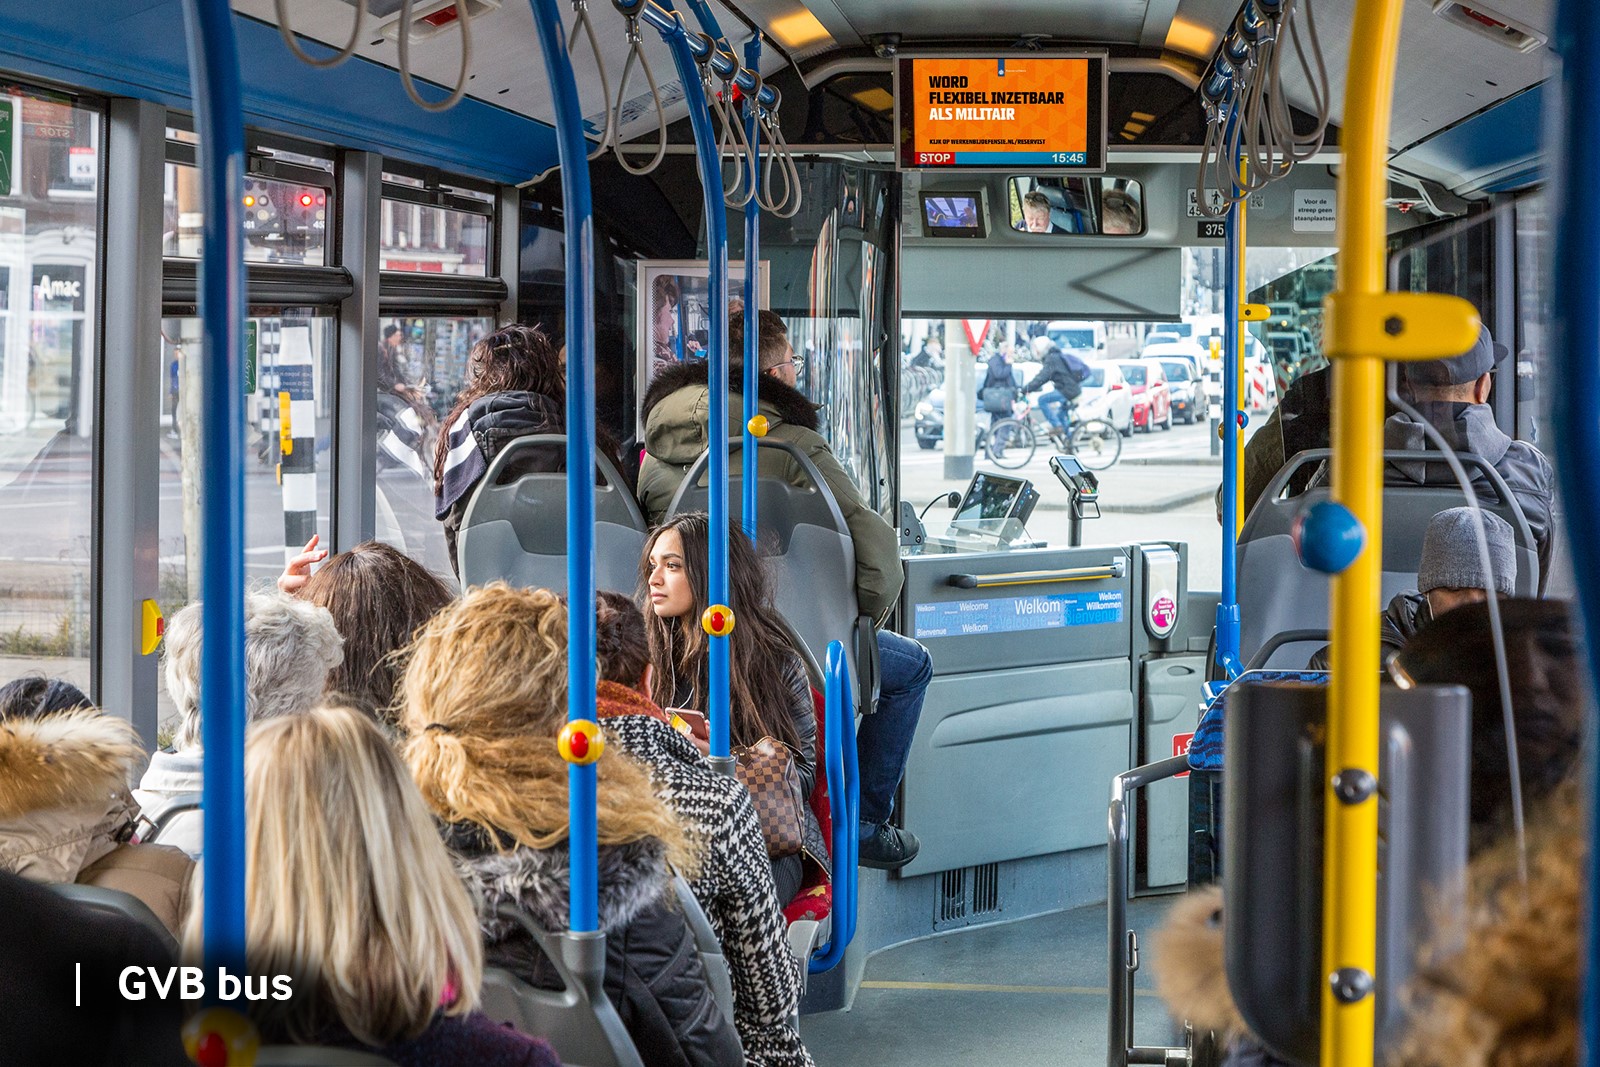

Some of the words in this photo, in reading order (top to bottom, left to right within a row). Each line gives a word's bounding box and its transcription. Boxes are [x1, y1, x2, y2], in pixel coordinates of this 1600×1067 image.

[929, 75, 969, 89] WORD
[929, 91, 989, 105] FLEXIBEL
[991, 91, 1064, 105] INZETBAAR
[929, 107, 953, 121] ALS
[955, 107, 1016, 121] MILITAIR
[919, 153, 951, 163] STOP
[1051, 153, 1085, 163] 15:45
[1205, 223, 1225, 236] 375
[38, 274, 81, 300] Amac
[1098, 592, 1122, 601] Welkom
[959, 603, 989, 612] Welcome
[1014, 598, 1060, 615] Welkom
[1086, 601, 1122, 610] Willkommen
[916, 628, 947, 637] Bienvenue
[961, 623, 989, 633] Welkom
